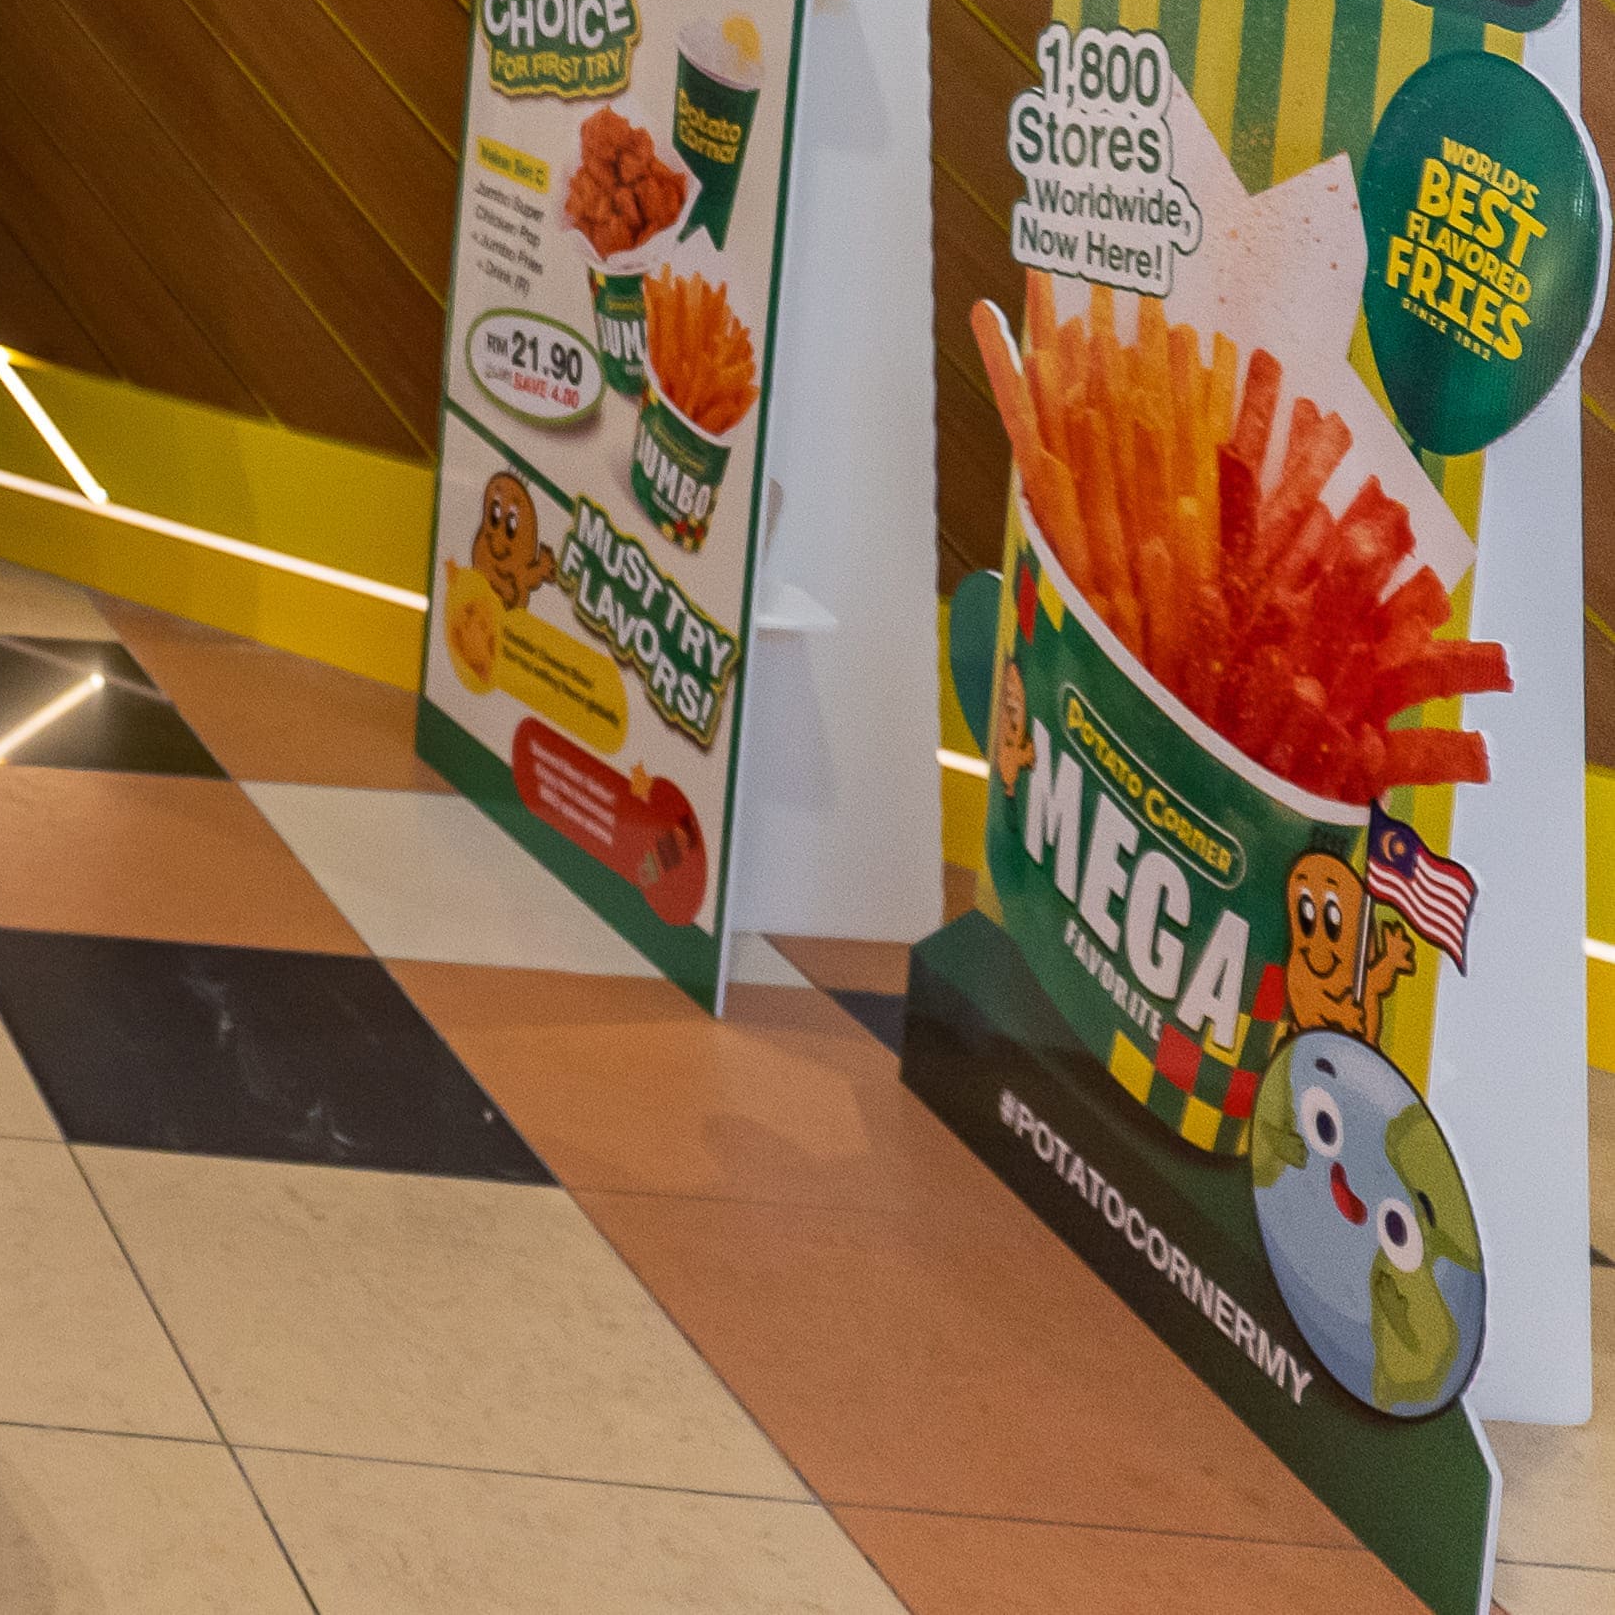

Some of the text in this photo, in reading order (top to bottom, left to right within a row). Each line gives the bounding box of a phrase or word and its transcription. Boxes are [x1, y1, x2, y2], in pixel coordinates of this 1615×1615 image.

[495, 50, 529, 81] FOR
[585, 48, 621, 81] TRY
[1045, 38, 1161, 109] 1,800
[1017, 106, 1162, 174] Stores
[1442, 136, 1540, 210] WORLD'S
[1021, 216, 1162, 281] Now Here!
[1035, 179, 1191, 236] Worldwide,
[1407, 210, 1532, 304] FLAVORED
[1416, 157, 1548, 267] BEST
[1386, 235, 1531, 361] FRIES
[512, 330, 582, 386] 21.90
[562, 540, 715, 734] FLAVORS!
[577, 503, 664, 603] MUST
[661, 583, 735, 678] TRY
[1067, 697, 1232, 875] POTATO CORNER
[1024, 716, 1250, 1050] MEGA
[1064, 918, 1164, 1042] FAVORITE
[999, 1087, 1314, 1404] #POTATOCORNERMY
